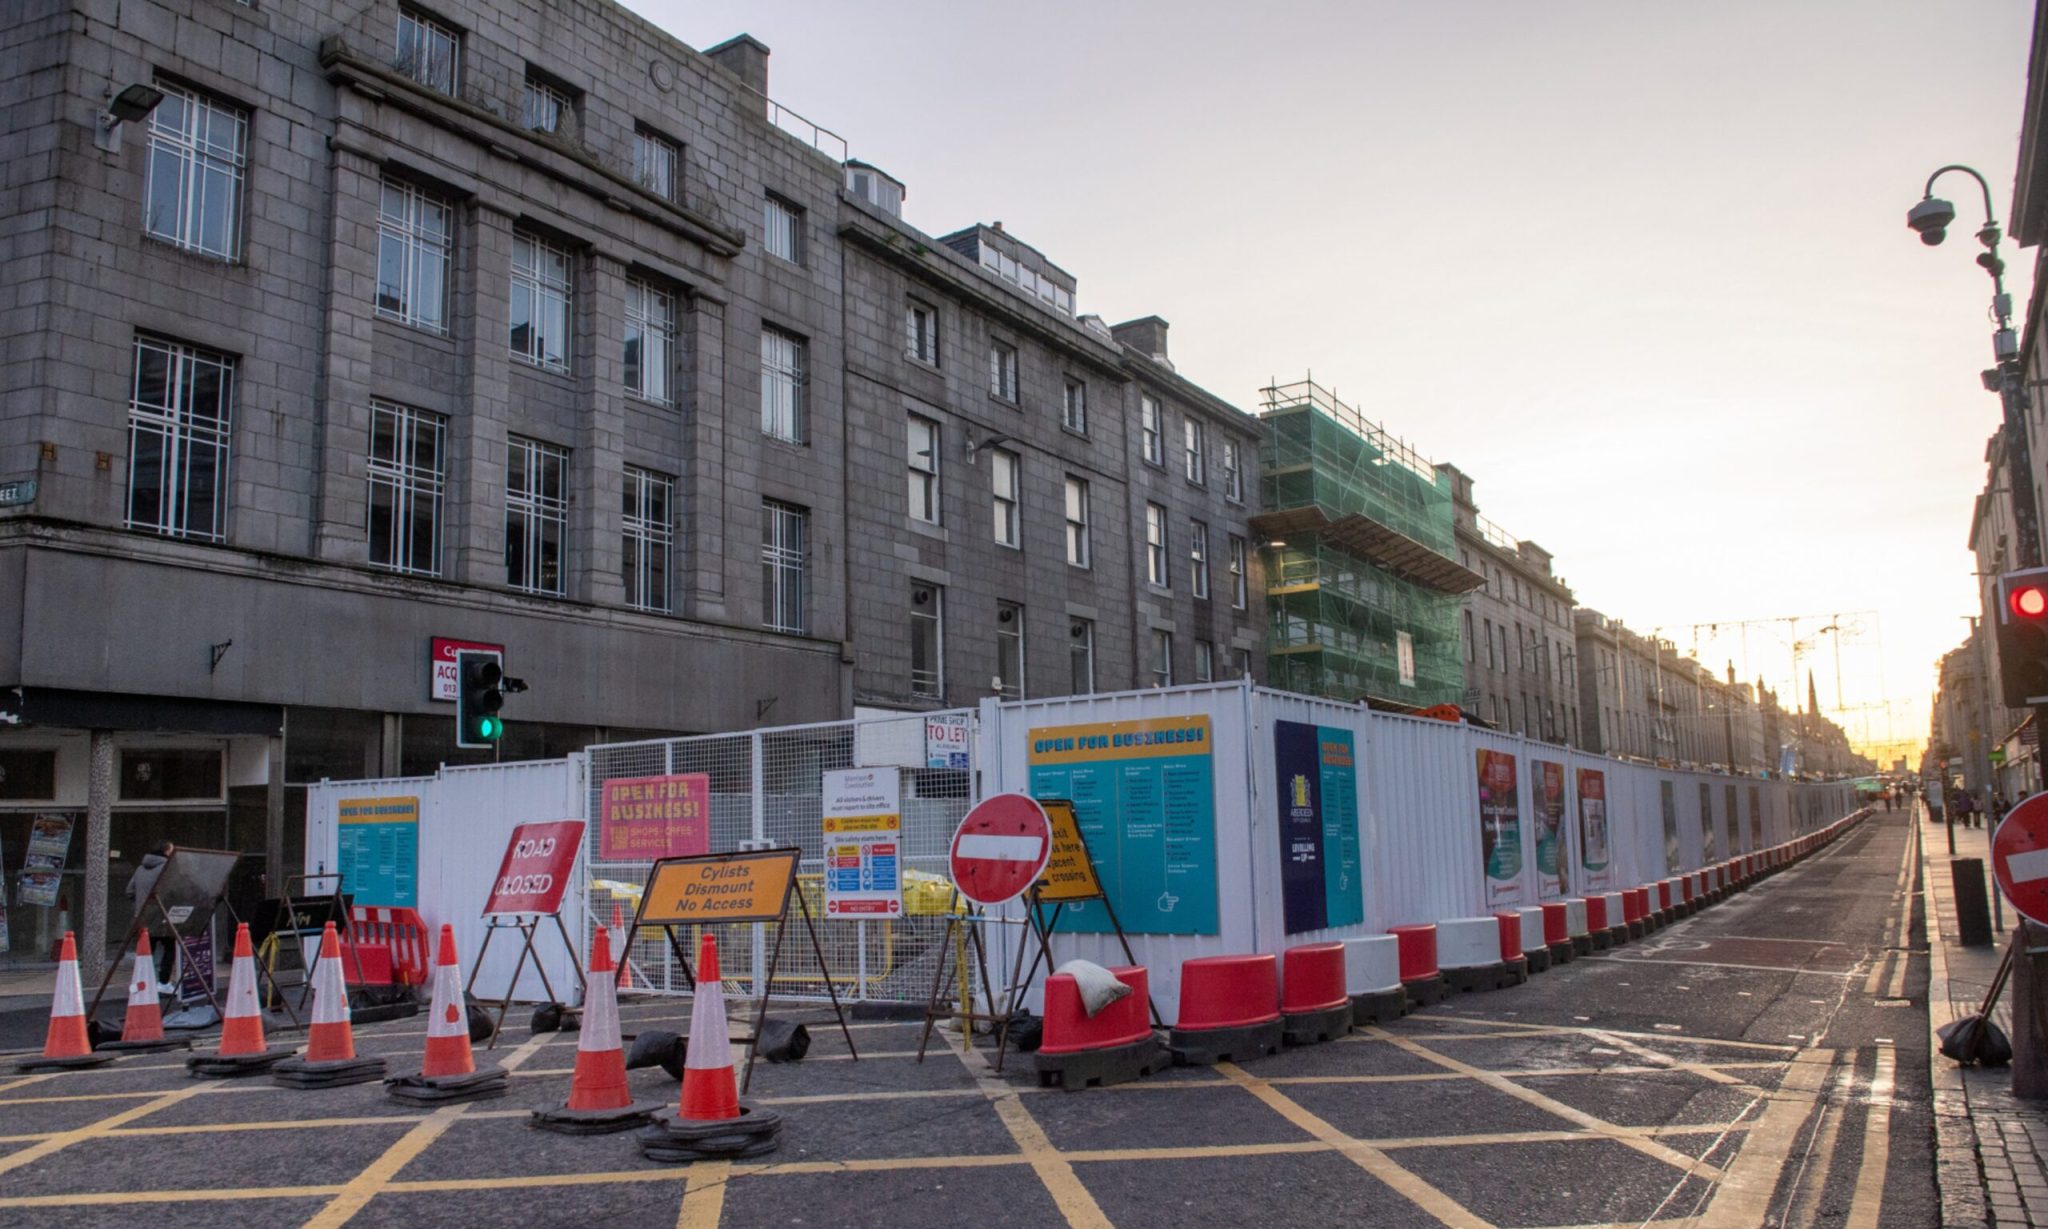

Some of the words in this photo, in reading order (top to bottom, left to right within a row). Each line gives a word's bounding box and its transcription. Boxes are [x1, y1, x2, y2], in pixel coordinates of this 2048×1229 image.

[928, 724, 945, 741] TO
[947, 726, 968, 743] LET
[1034, 736, 1074, 753] OPEN
[1078, 734, 1109, 750] FOR
[1112, 727, 1204, 748] BUSINESS!
[611, 783, 655, 801] OPEN
[659, 782, 689, 799] FOR
[611, 800, 699, 821] BUSINESS!
[513, 838, 556, 859] ROAD
[701, 865, 751, 881] Cylists
[495, 874, 553, 896] CLOSED
[684, 880, 755, 896] Dismount
[675, 899, 697, 912] No
[701, 897, 753, 911] Access
